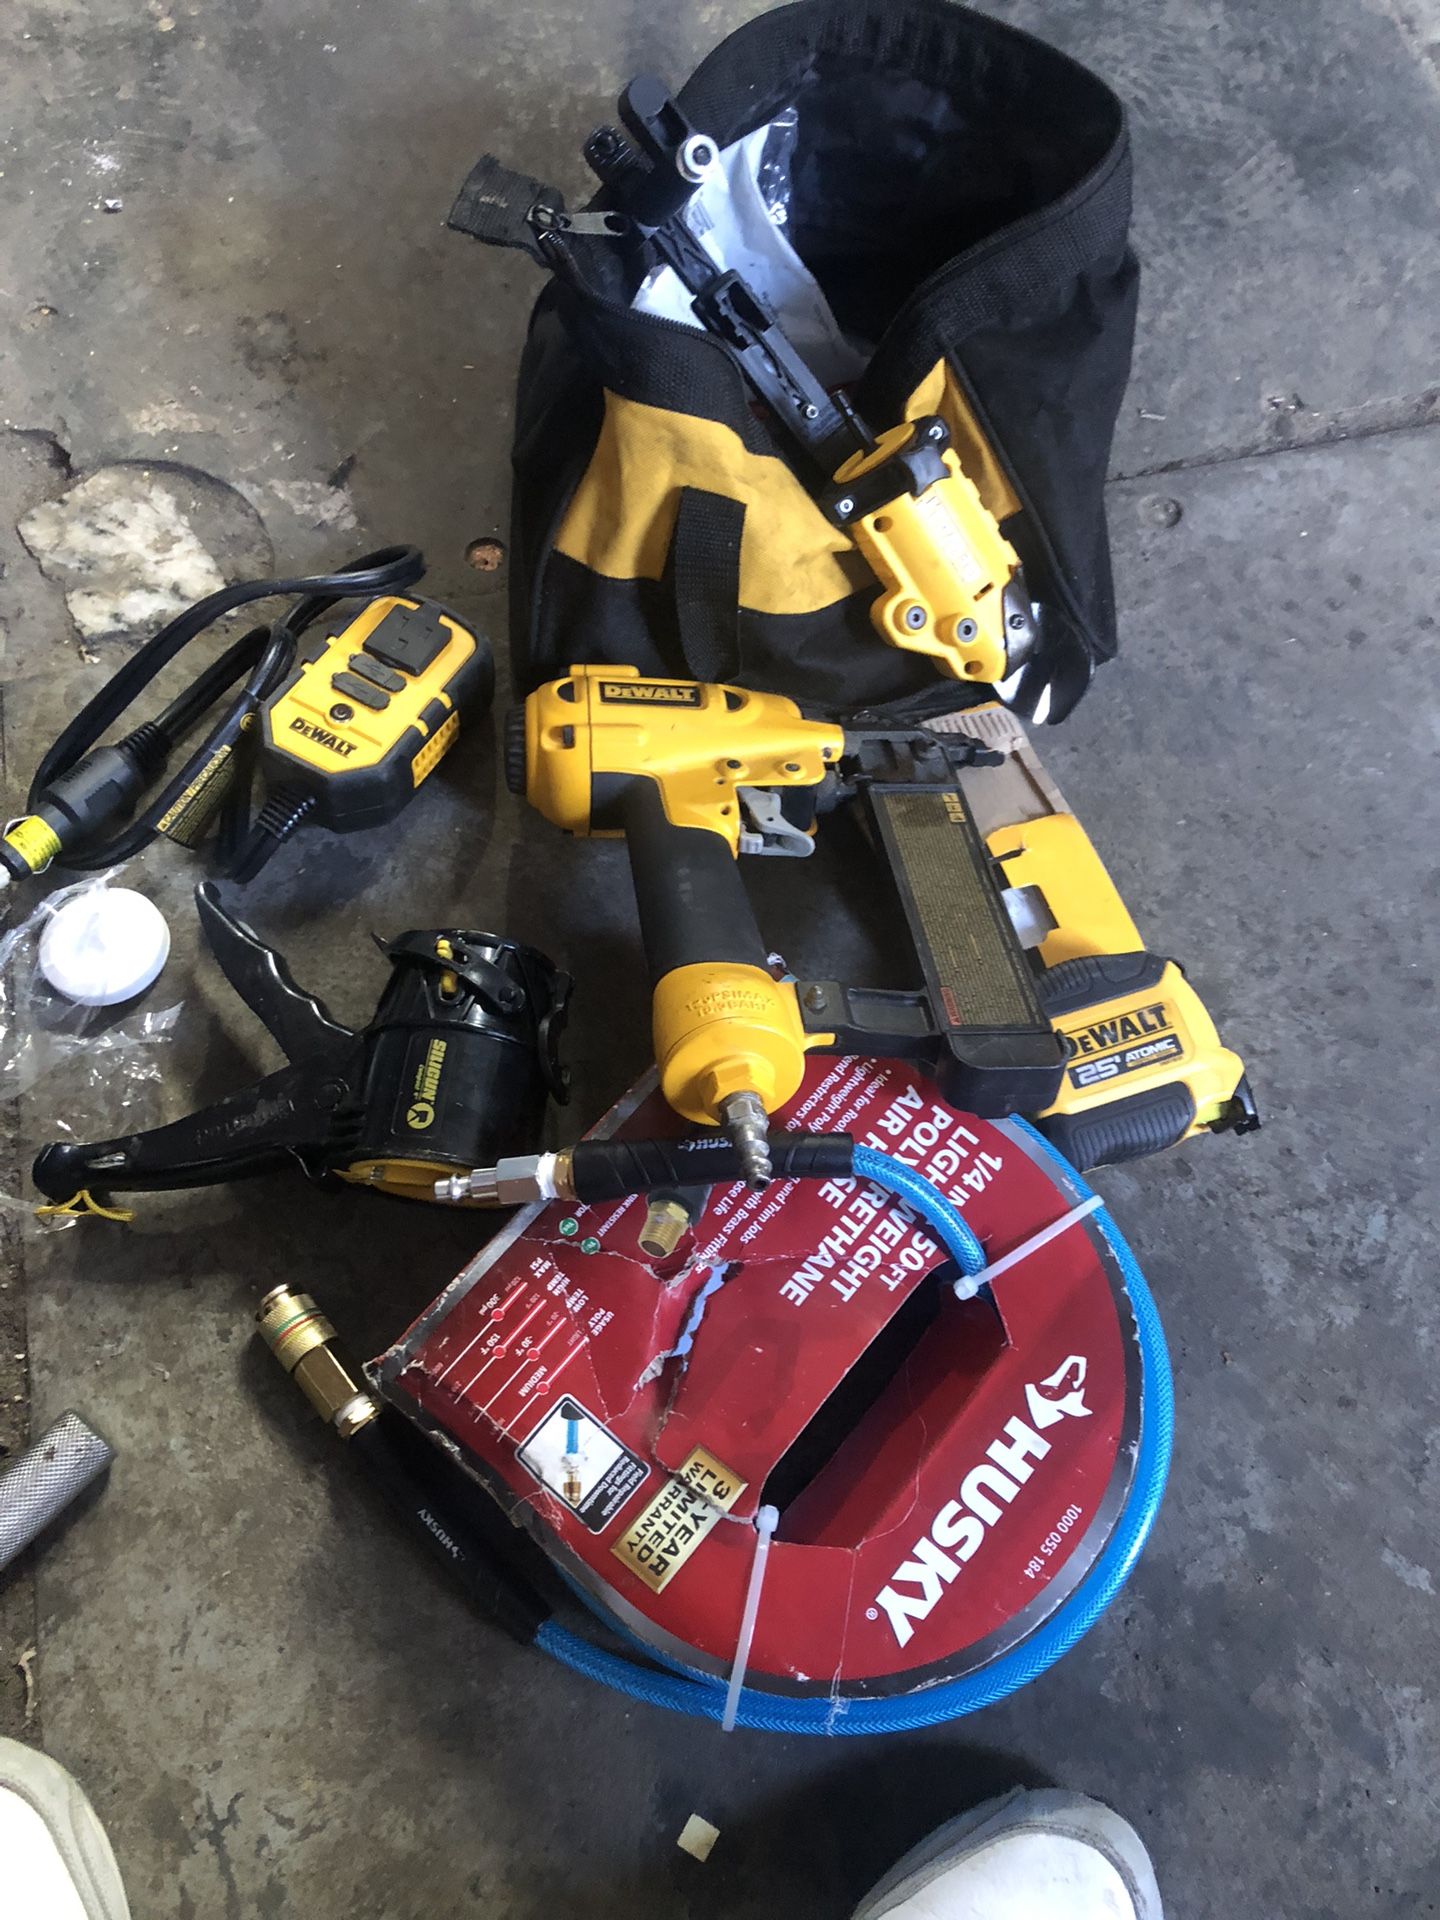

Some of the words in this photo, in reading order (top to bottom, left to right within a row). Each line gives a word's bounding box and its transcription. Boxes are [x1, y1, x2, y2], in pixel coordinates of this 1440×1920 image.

[1125, 1038, 1175, 1063] ATOMIC
[422, 1039, 447, 1100] SILIGUN
[796, 1072, 840, 1119] Restrictors
[825, 1062, 874, 1114] Lightweight
[864, 1073, 888, 1099] Ideal
[853, 1095, 870, 1111] for
[877, 1084, 924, 1143] AIR
[962, 1151, 1003, 1193] 1/4
[713, 1196, 734, 1216] Life
[775, 1181, 794, 1205] and
[597, 1206, 626, 1237] RESISTANT
[722, 1208, 750, 1235] Brass
[758, 1201, 782, 1223] Trim
[740, 1220, 763, 1244] Jobs
[529, 1257, 544, 1270] PSI
[901, 1233, 938, 1271] 50
[533, 1260, 552, 1279] MAX
[546, 1271, 566, 1291] TEMP
[880, 1263, 911, 1292] FT
[552, 1276, 571, 1297] HIGH
[565, 1288, 585, 1309] TEMP
[572, 1295, 590, 1313] LOW
[587, 1307, 607, 1329] POLY
[590, 1311, 615, 1337] USAGE
[517, 1365, 548, 1397] MEDIUM
[626, 1461, 704, 1553] WARRANTY
[635, 1468, 718, 1565] LIMITED
[1056, 1504, 1082, 1533] 1000
[417, 1508, 454, 1549] HUSKY
[875, 1415, 1052, 1649] HUSKY
[1040, 1532, 1062, 1556] 055
[1023, 1556, 1045, 1579] 184
